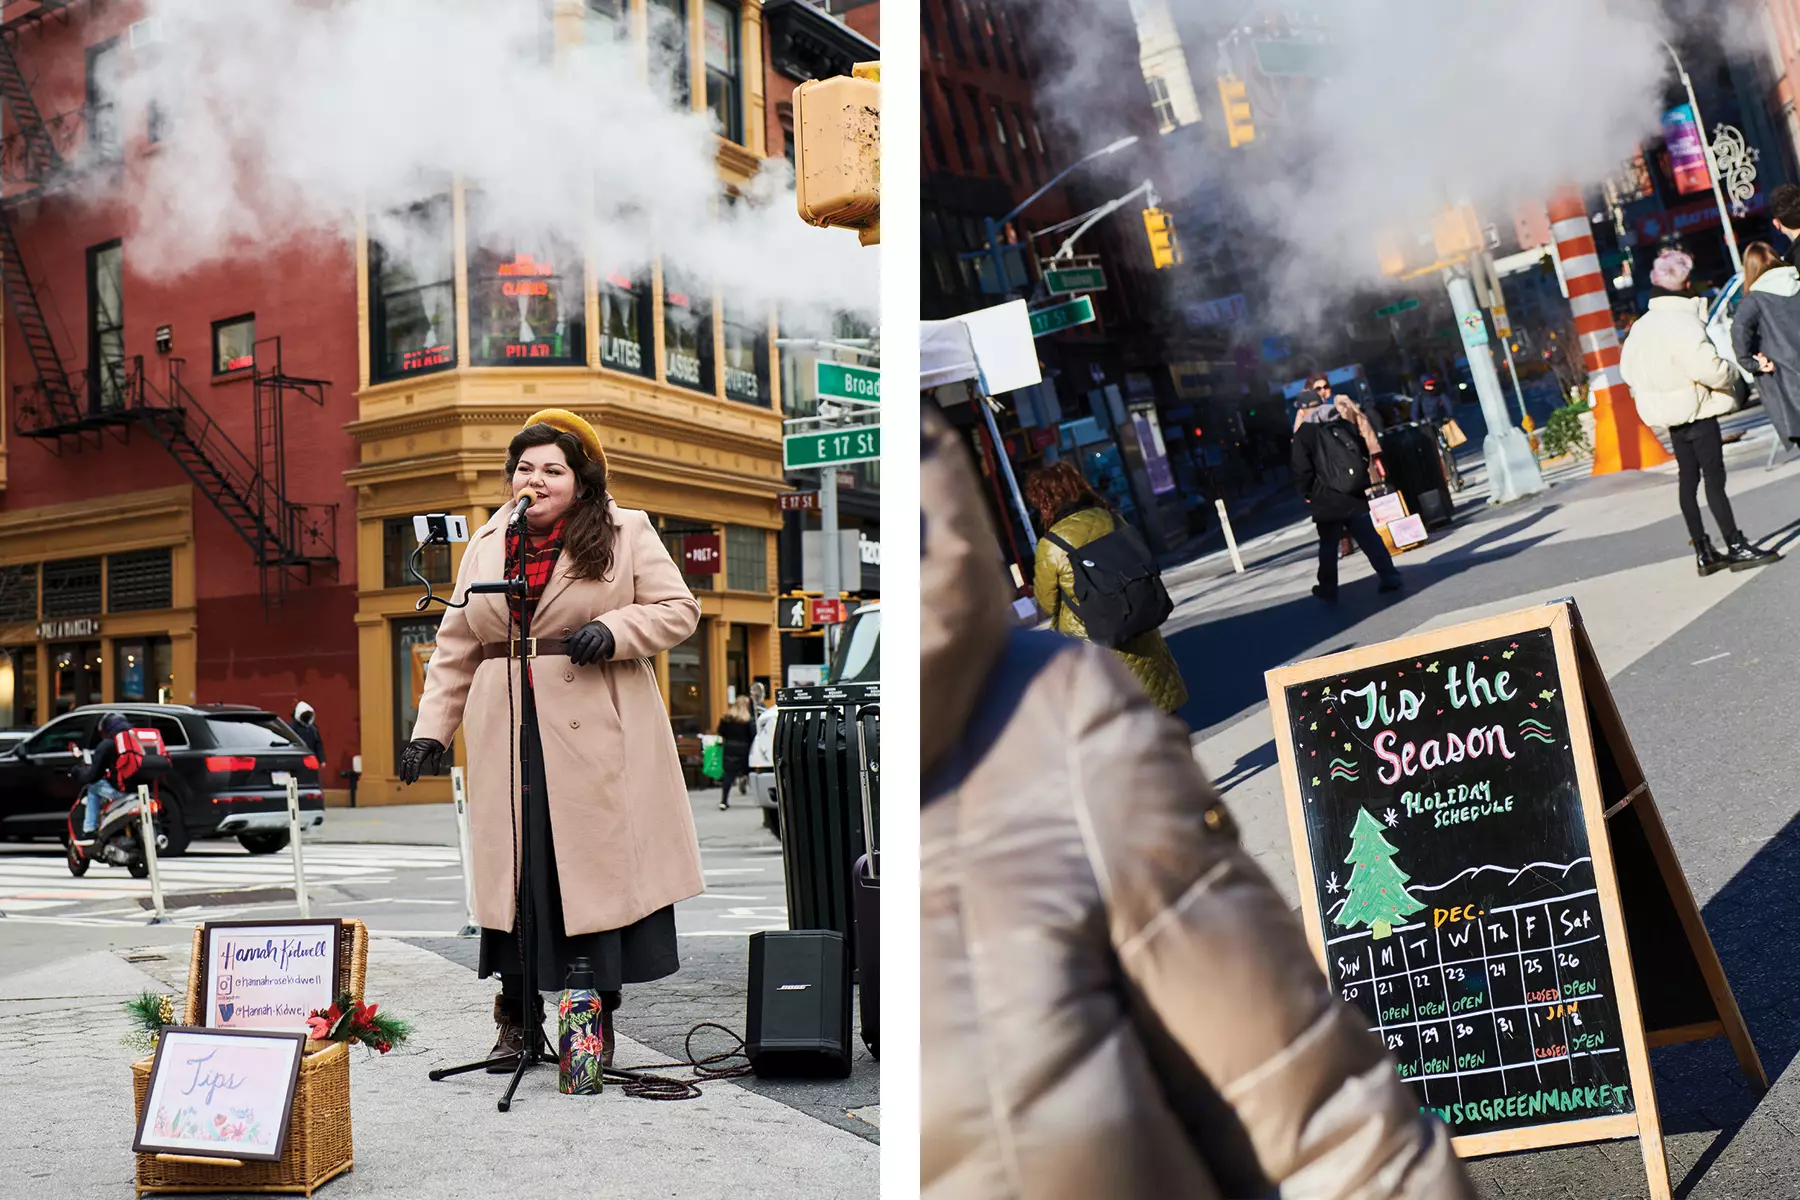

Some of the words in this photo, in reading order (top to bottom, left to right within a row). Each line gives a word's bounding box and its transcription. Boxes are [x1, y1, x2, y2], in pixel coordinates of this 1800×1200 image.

[600, 334, 641, 368] ILATES
[665, 353, 700, 383] LASSES
[817, 438, 826, 458] E
[833, 436, 849, 456] 17
[857, 433, 874, 454] St
[781, 497, 787, 509] E
[790, 495, 799, 508] 17
[1444, 661, 1518, 709] the
[1373, 724, 1516, 785] Season
[1400, 780, 1491, 818] HOLIDAY
[1434, 795, 1515, 828] SCHEDULE
[1433, 904, 1485, 928] DEC.
[220, 939, 278, 970] Hannah
[279, 939, 326, 971] Kidwell
[1381, 946, 1395, 967] M
[1409, 939, 1428, 958] T
[1448, 923, 1471, 947] W
[1487, 923, 1509, 943] Th
[1526, 916, 1536, 938] F
[1342, 988, 1358, 1001] 20
[1378, 982, 1393, 995] 21
[1414, 975, 1430, 988] 22
[1445, 968, 1466, 981] 23
[1489, 962, 1506, 977] 24
[1524, 959, 1543, 973] 25
[1558, 953, 1580, 968] 26
[1381, 1003, 1410, 1021] OPEN
[1418, 999, 1445, 1016] OPEN
[1452, 991, 1483, 1012] OPEN
[1526, 988, 1559, 1003] CLOSED
[1563, 978, 1597, 995] OPEN
[1546, 1001, 1578, 1020] JAN
[1387, 1033, 1404, 1050] 28
[1421, 1027, 1439, 1043] 29
[1456, 1023, 1474, 1039] 30
[1497, 1017, 1514, 1032] 31
[1534, 1012, 1541, 1028] 1
[1394, 1059, 1418, 1077] PEN
[1424, 1056, 1450, 1073] OPEN
[1458, 1050, 1485, 1068] OPEN
[1535, 1044, 1567, 1058] CLOSED
[1573, 1030, 1604, 1050] OPEN
[181, 1046, 248, 1106] Tips
[1419, 1084, 1628, 1125] NSQGREENMARKET
